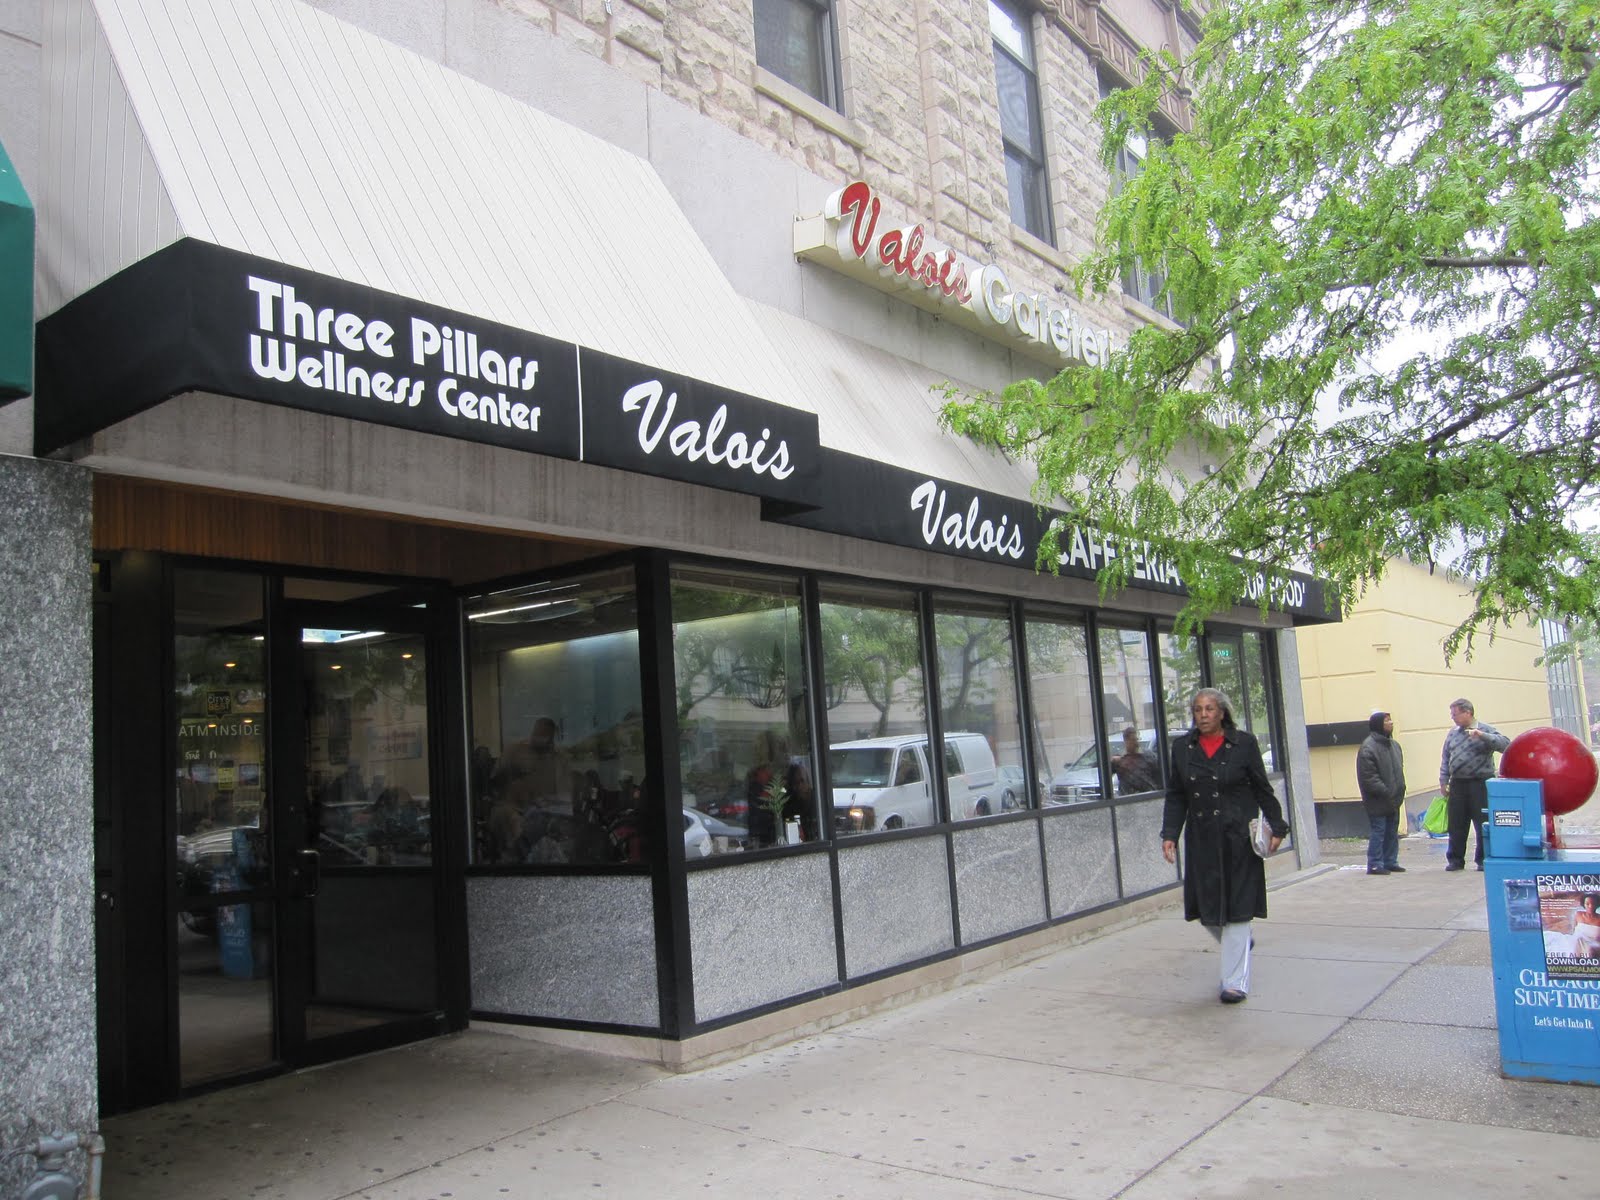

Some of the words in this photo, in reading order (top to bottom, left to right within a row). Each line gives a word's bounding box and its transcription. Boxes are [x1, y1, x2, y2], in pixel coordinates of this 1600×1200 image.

[829, 181, 973, 304] Valois
[248, 276, 395, 358] Three
[411, 317, 540, 391] Pillars
[250, 335, 426, 408] Wellness
[438, 379, 541, 432] Center
[622, 380, 795, 480] Valois
[911, 480, 1025, 559] Valois
[178, 725, 209, 736] ATM
[215, 724, 261, 736] INSIDE
[1546, 957, 1599, 966] DOWNLOAD
[1534, 1015, 1552, 1027] Let's
[1553, 1016, 1566, 1027] Get
[1567, 1017, 1584, 1028] Into
